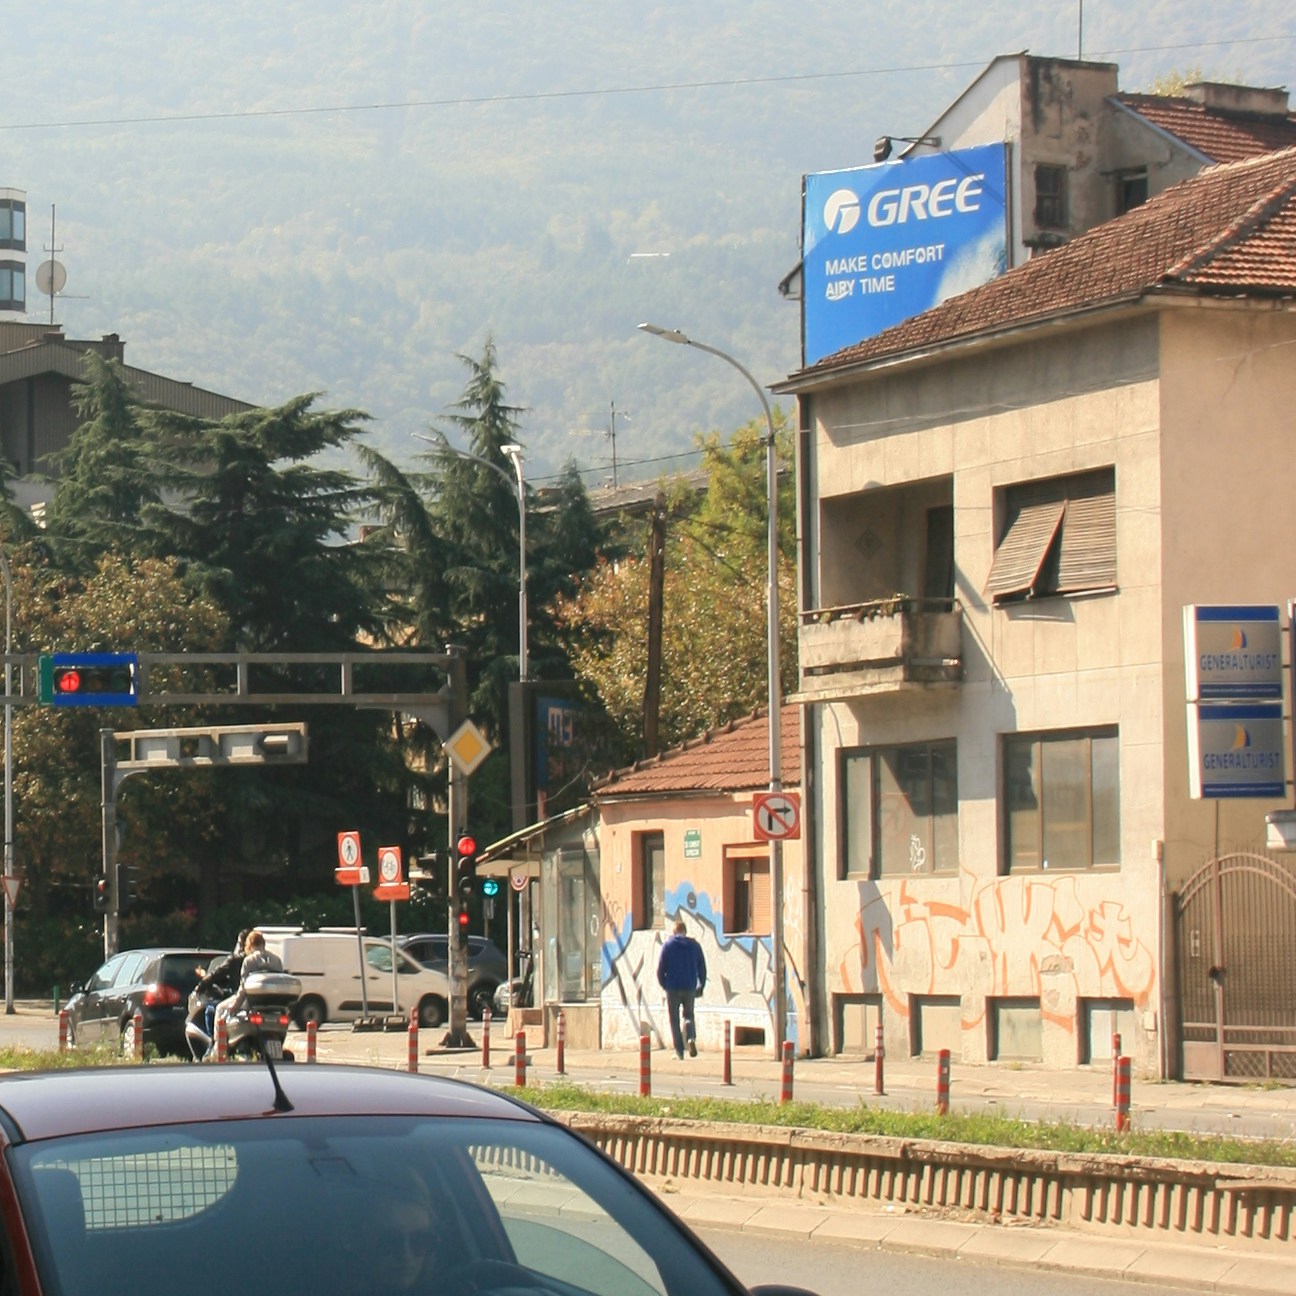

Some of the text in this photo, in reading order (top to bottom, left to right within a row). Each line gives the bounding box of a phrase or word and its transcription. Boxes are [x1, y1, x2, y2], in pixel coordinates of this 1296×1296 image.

[868, 174, 984, 227] GREE
[825, 244, 945, 276] MAKE COMFORT
[860, 275, 895, 294] TIME
[1200, 654, 1277, 671] GENERALTURIST
[1203, 752, 1280, 769] GENERALTURIST
